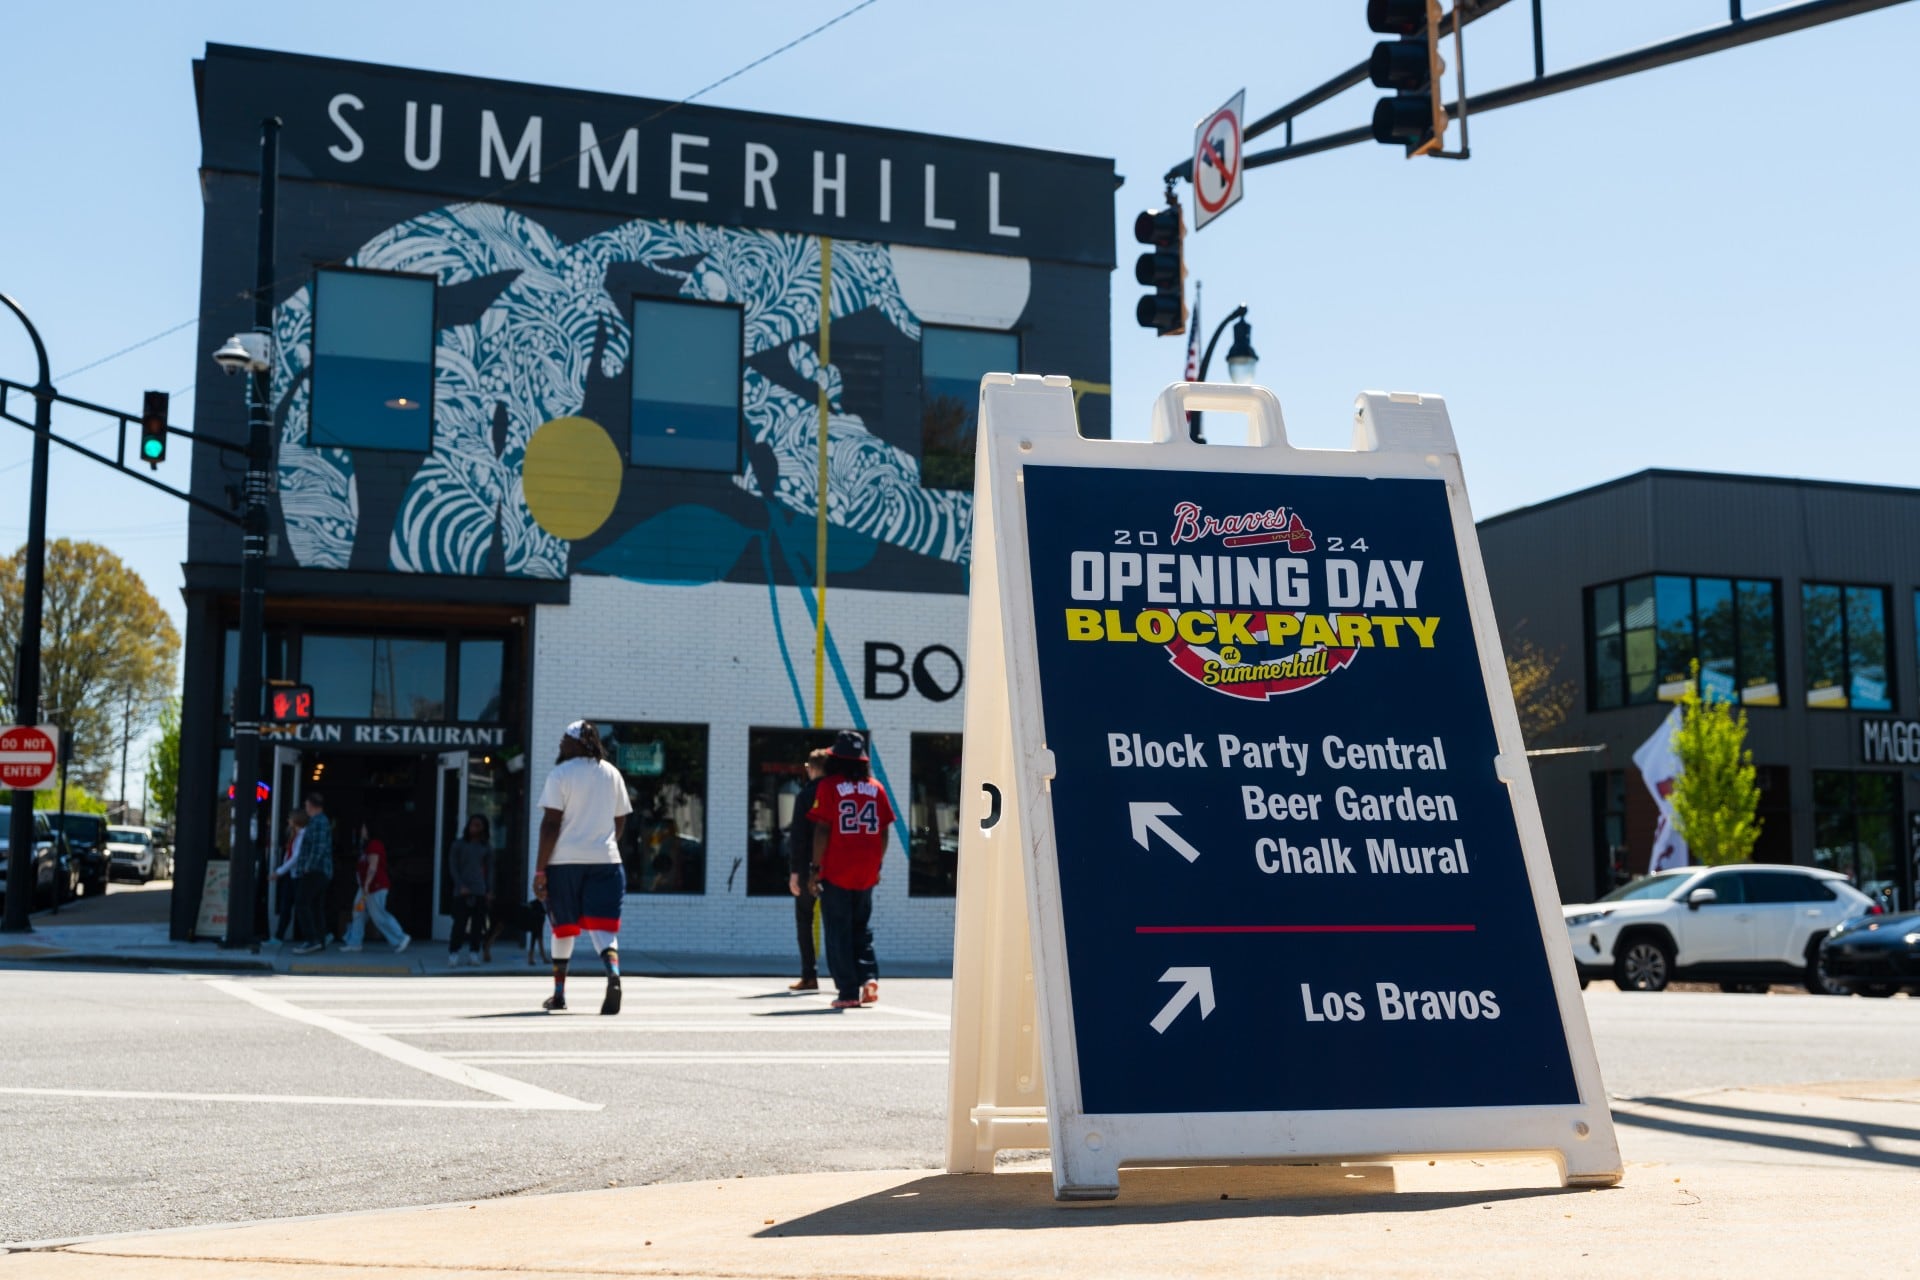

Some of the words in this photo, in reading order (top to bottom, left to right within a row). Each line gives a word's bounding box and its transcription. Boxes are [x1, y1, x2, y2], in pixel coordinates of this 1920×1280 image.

[328, 93, 1020, 237] SUMMERHILL
[1114, 530, 1158, 546] 20
[1171, 501, 1287, 545] Braves
[1327, 537, 1369, 552] 24
[1070, 551, 1310, 607] OPENING
[1325, 558, 1424, 609] DAY
[1065, 608, 1258, 645] BLOCK
[1265, 613, 1440, 648] PARTY
[1203, 651, 1330, 685] Summerhill
[1223, 648, 1237, 660] at
[295, 693, 311, 718] 12
[1, 738, 17, 749] DO
[24, 738, 46, 749] NOT
[230, 723, 342, 743] XICAN
[355, 725, 507, 745] RESTAURANT
[3, 765, 42, 777] ENTER
[1107, 732, 1208, 768] Block
[1218, 734, 1309, 776] Party
[1322, 735, 1447, 770] Central
[839, 800, 879, 834] 24
[1241, 785, 1321, 820] Beer
[1335, 786, 1458, 821] Garden
[1255, 838, 1357, 874] Chalk
[1366, 838, 1470, 874] Mural
[1300, 983, 1365, 1022] Los
[1376, 982, 1500, 1021] Bravos
